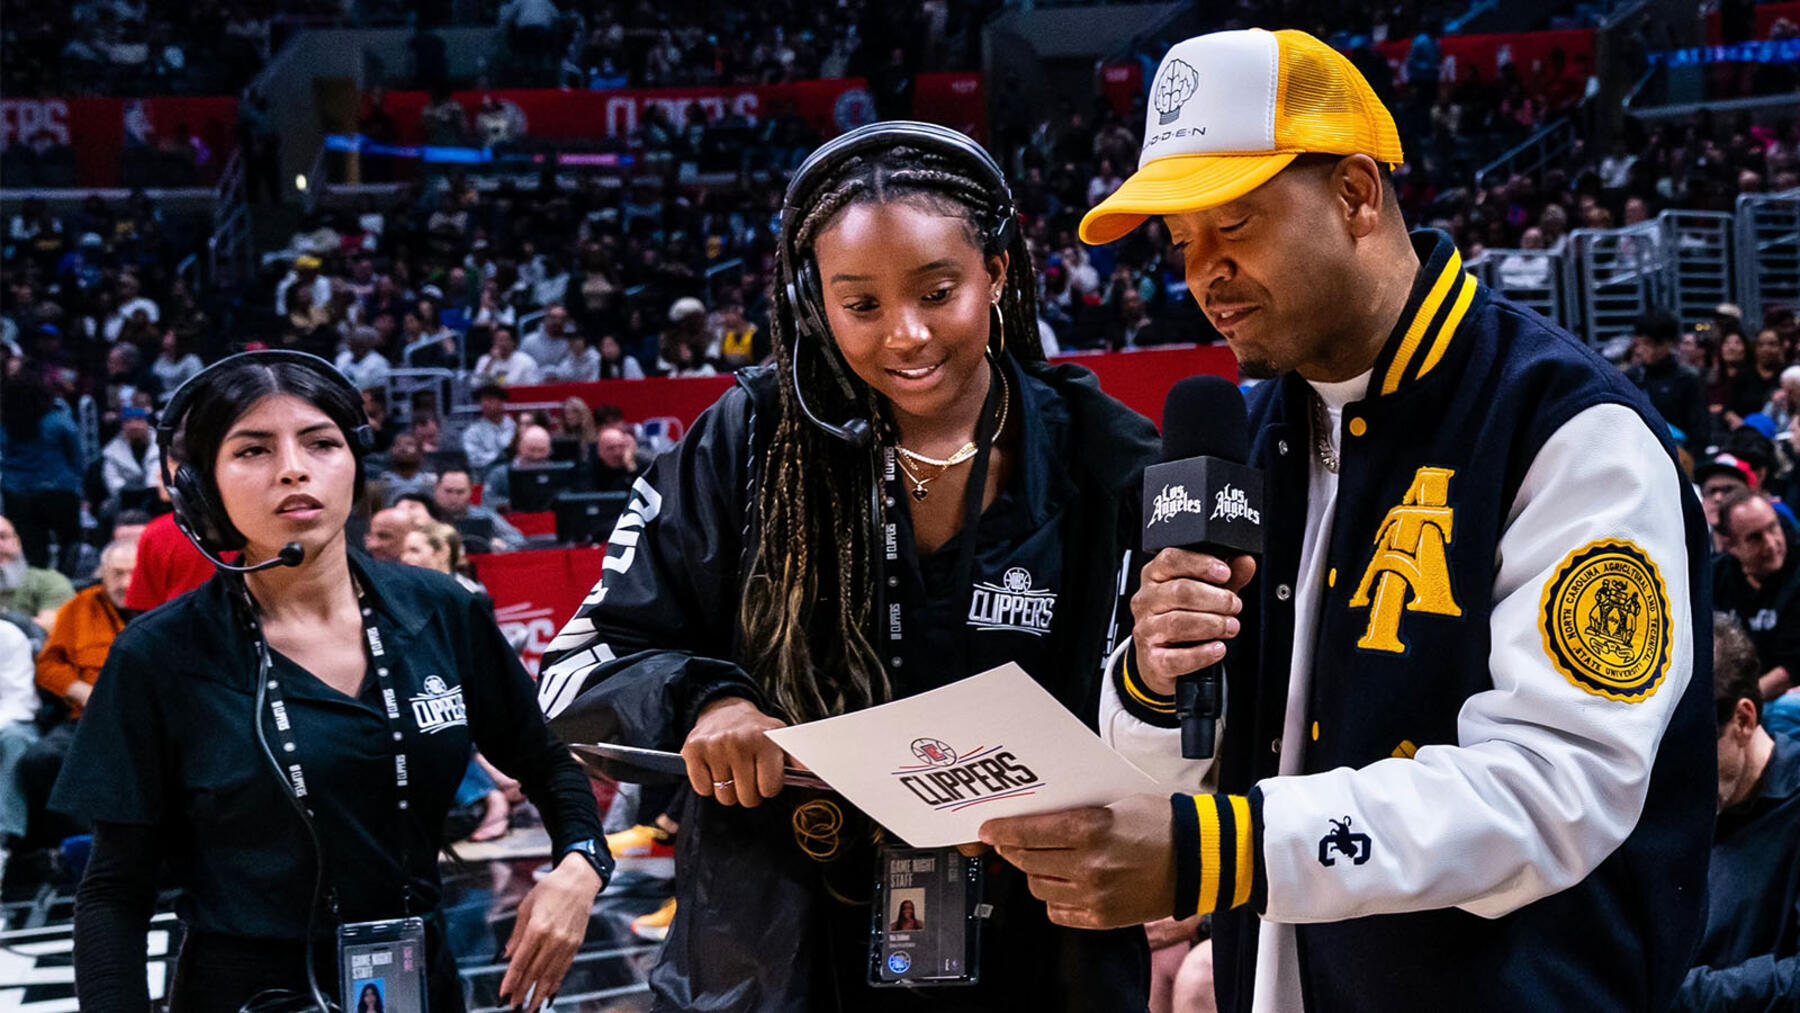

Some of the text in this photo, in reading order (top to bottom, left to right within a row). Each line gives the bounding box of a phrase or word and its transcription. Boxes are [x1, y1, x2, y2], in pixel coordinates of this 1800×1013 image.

[1162, 484, 1184, 501] Los
[1209, 490, 1260, 525] Angeles
[1224, 483, 1244, 503] Los
[1147, 491, 1201, 528] Angeles
[886, 523, 897, 552] CLIPPERS
[1566, 567, 1600, 604] CAROLINA
[889, 603, 901, 633] CLIPPERS
[968, 589, 1056, 628] CLIPPERS
[1647, 595, 1656, 613] AND
[1563, 608, 1576, 640] NORTH
[1575, 647, 1643, 677] STATE UNIVERSITY
[899, 751, 1039, 806] CLIPPERS
[890, 873, 913, 888] STAFF
